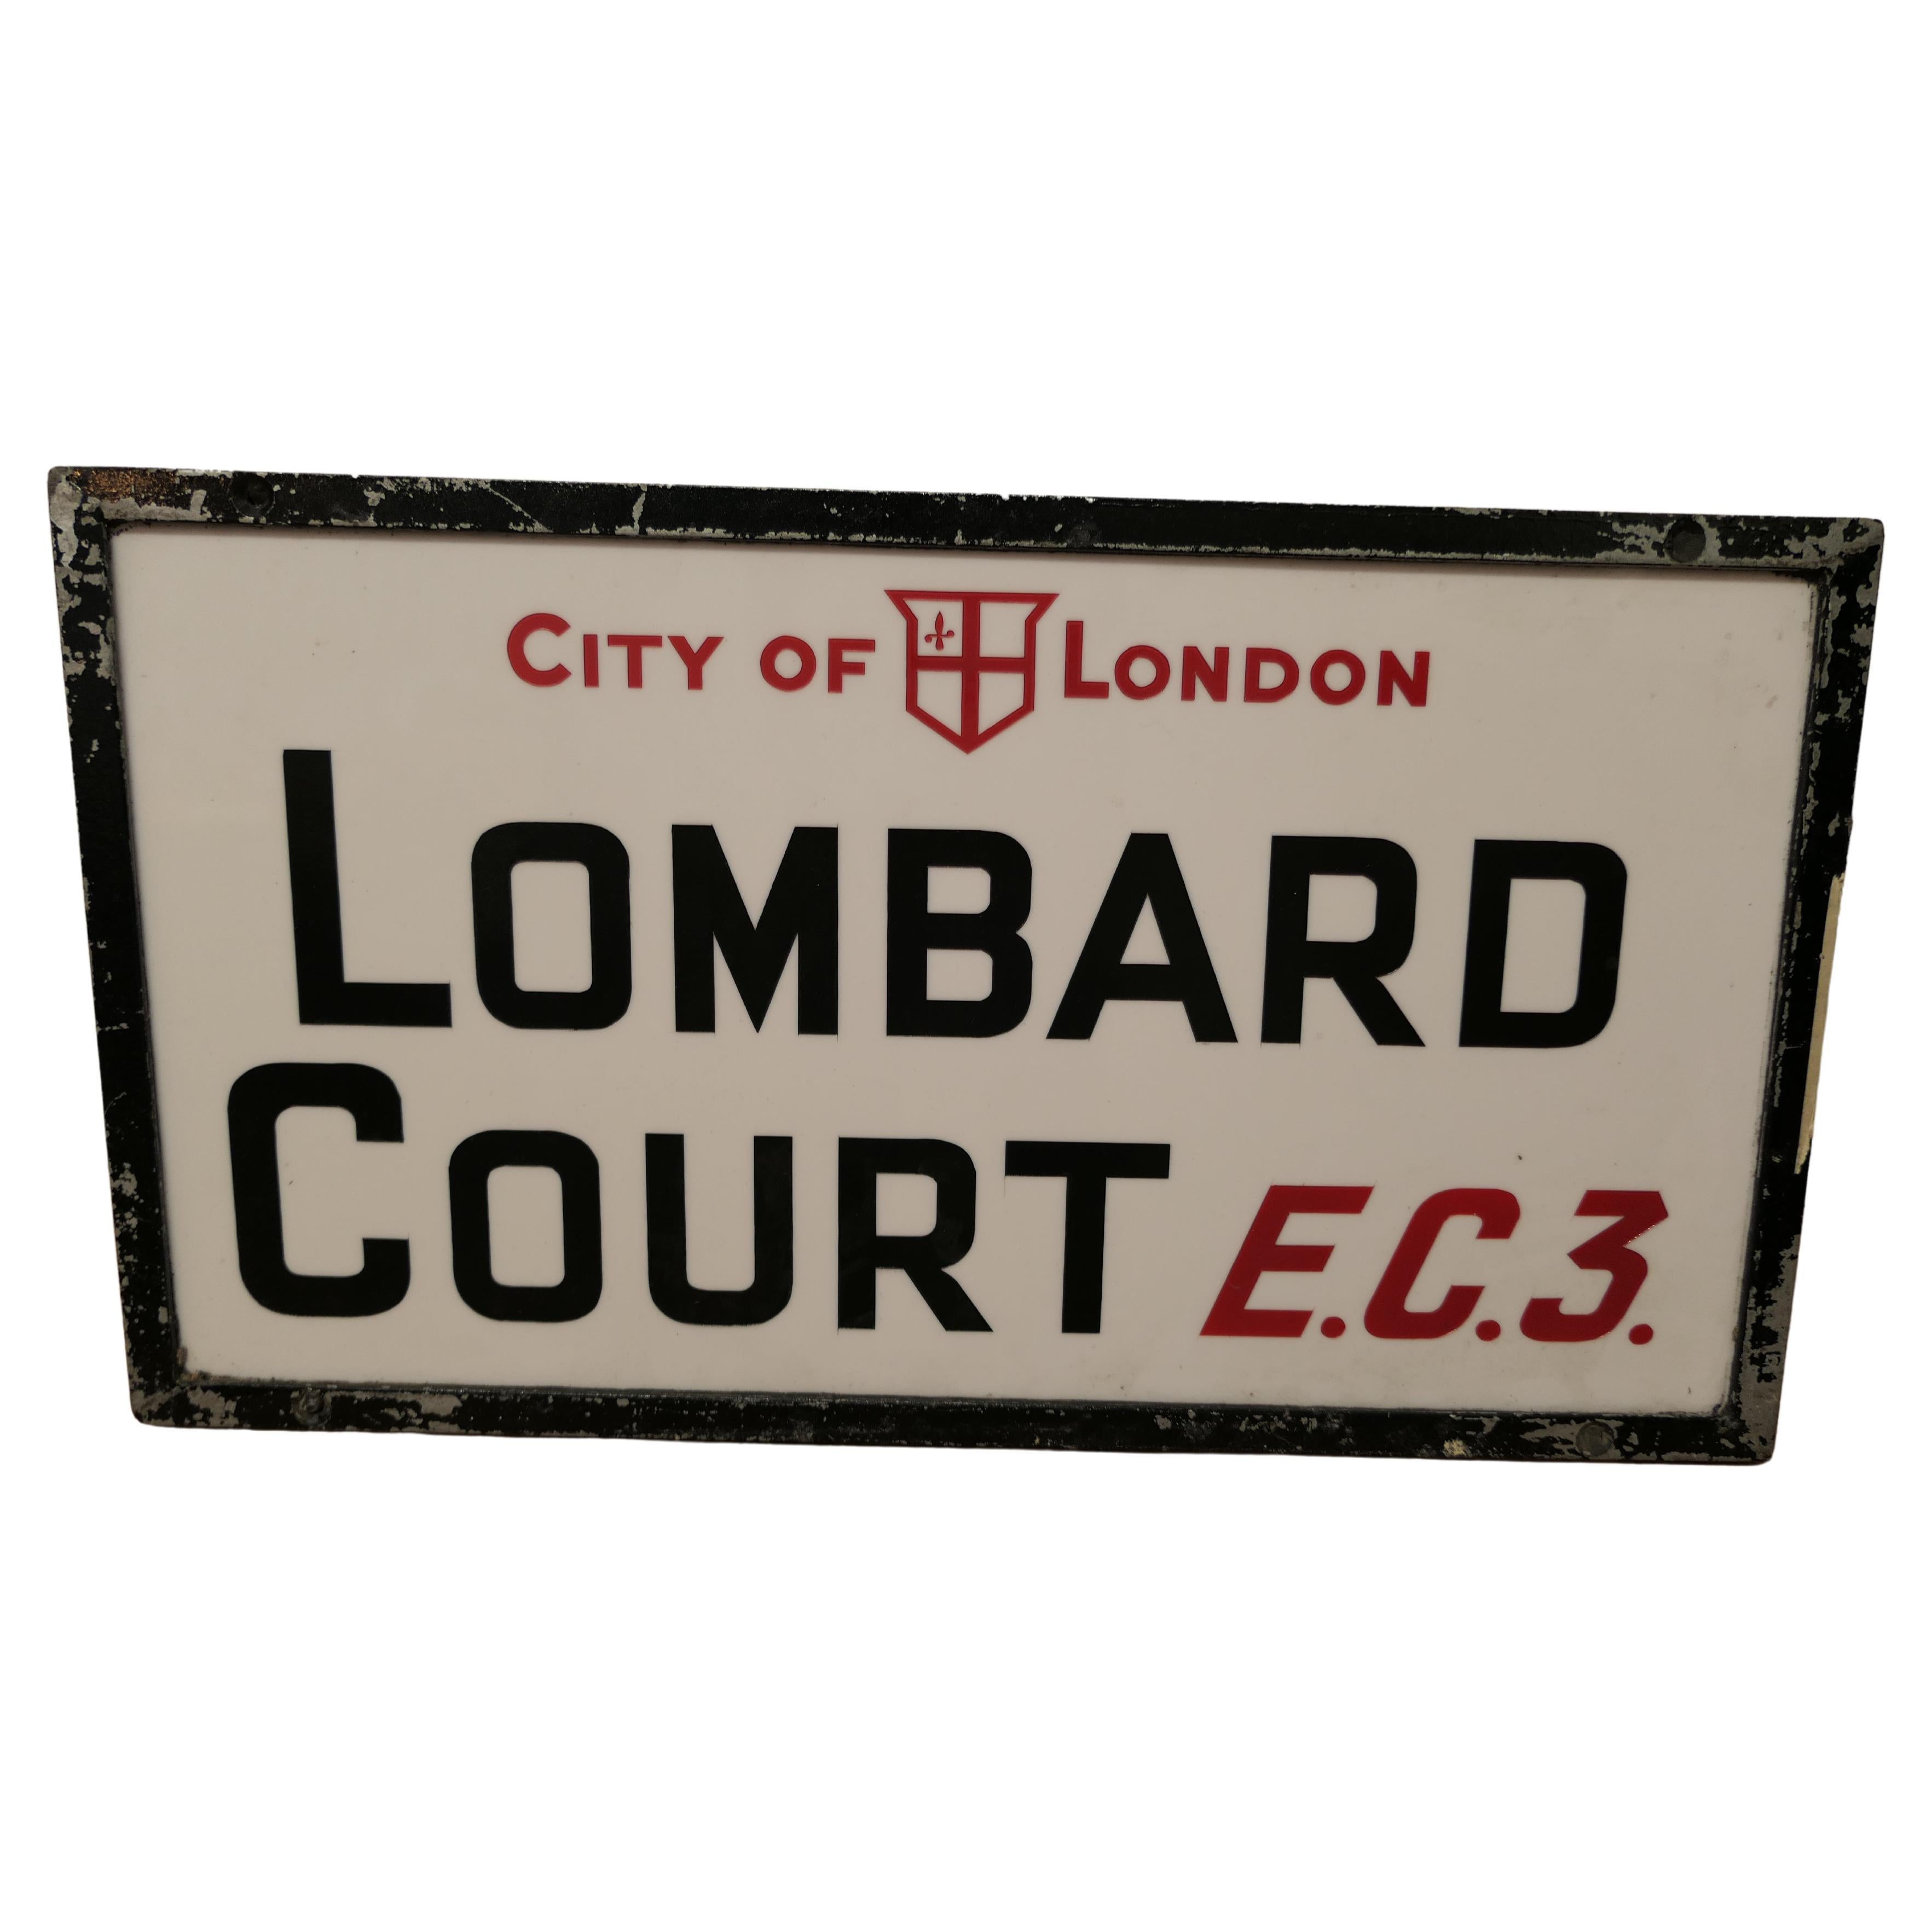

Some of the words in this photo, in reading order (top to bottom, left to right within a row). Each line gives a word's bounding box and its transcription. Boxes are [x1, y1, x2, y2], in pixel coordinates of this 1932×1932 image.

[506, 612, 724, 690] CITY
[759, 634, 876, 694] OF
[1063, 620, 1431, 708] LONDON
[282, 749, 1629, 1050] LOMBARD
[226, 1061, 1171, 1335] COURT
[1199, 1184, 1670, 1346] E.C.3.
